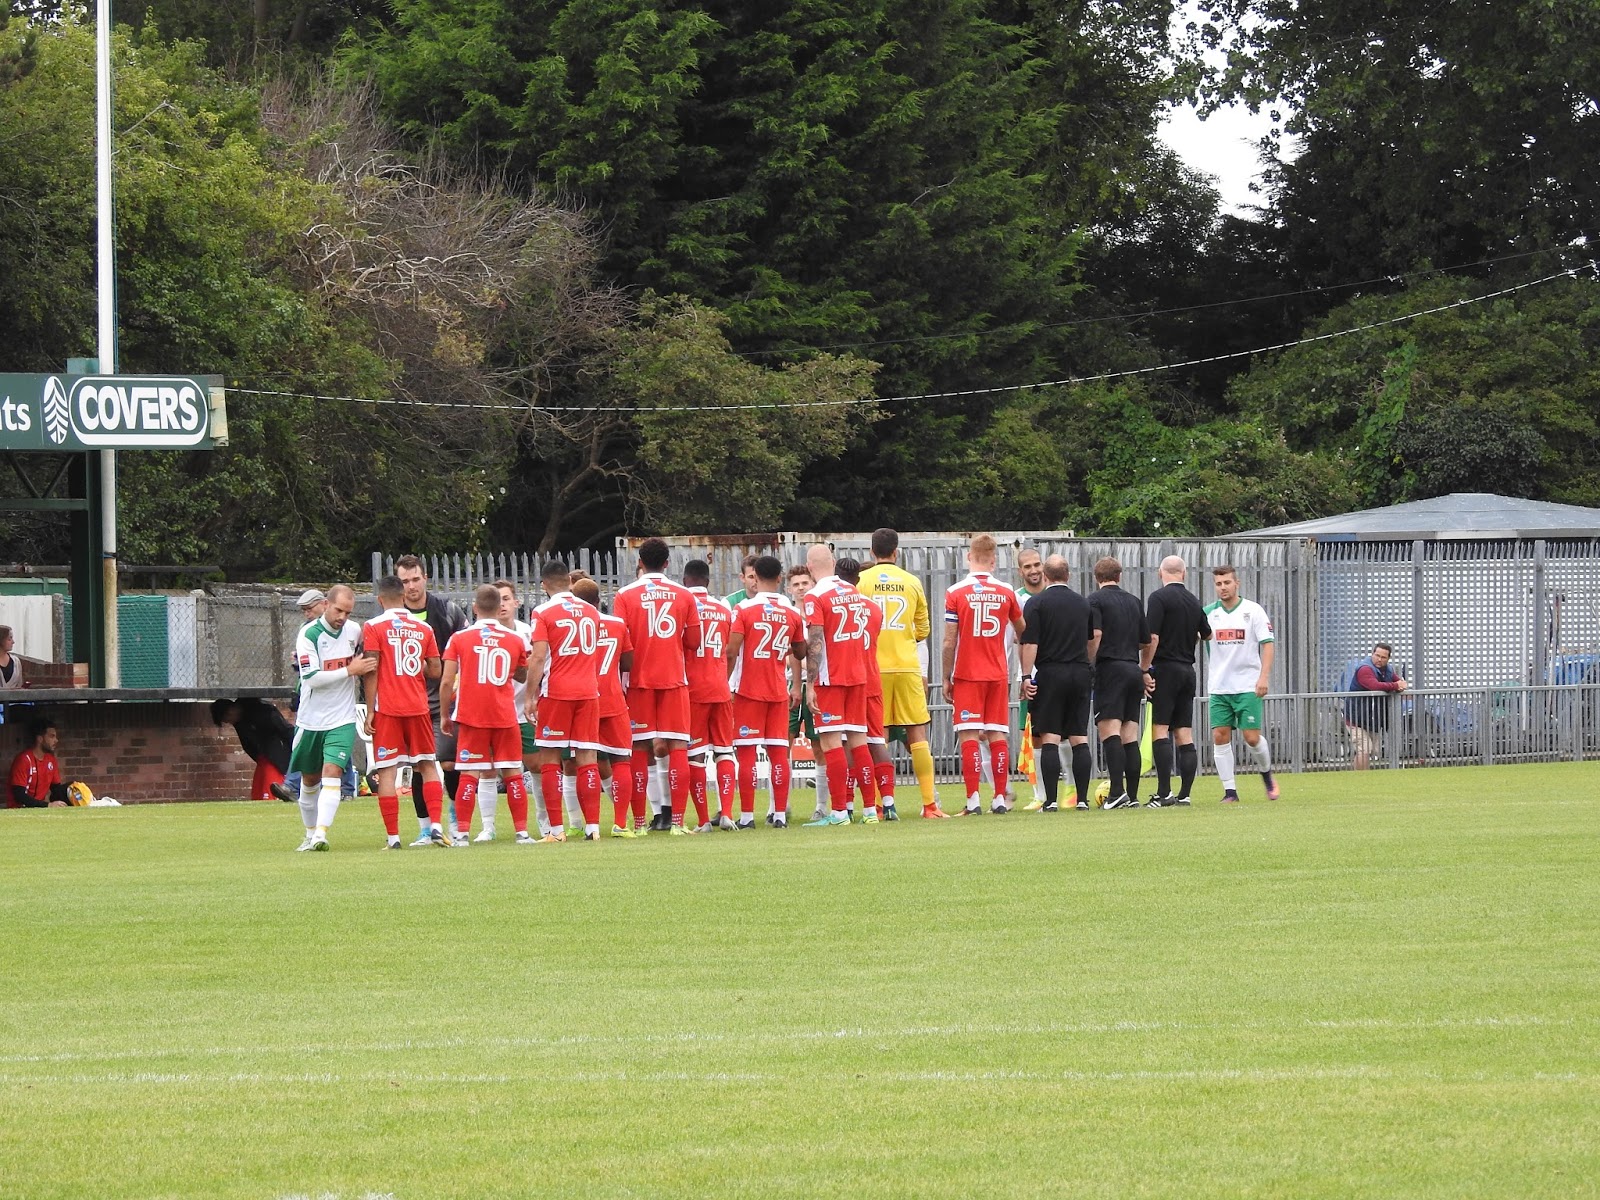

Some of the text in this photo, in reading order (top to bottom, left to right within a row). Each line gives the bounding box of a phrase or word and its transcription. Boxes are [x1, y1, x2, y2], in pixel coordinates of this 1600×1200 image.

[0, 395, 31, 431] ts
[78, 385, 199, 431] COVERS
[640, 591, 677, 601] GARNETT
[874, 583, 905, 592] MERSIN
[965, 593, 1007, 603] YORWERTH
[641, 601, 677, 639] 16
[762, 612, 787, 624] LEWIS
[831, 602, 866, 643] 23
[871, 594, 906, 630] 12
[968, 601, 1001, 638] 15
[386, 629, 424, 640] CLIFFORD
[482, 638, 500, 647] COX
[555, 616, 597, 657] 20
[696, 620, 723, 658] 14
[753, 621, 790, 661] 24
[1217, 630, 1245, 639] FRH
[387, 638, 423, 677] 18
[473, 646, 511, 686] 10
[596, 637, 618, 676] 7
[794, 760, 816, 769] footb
